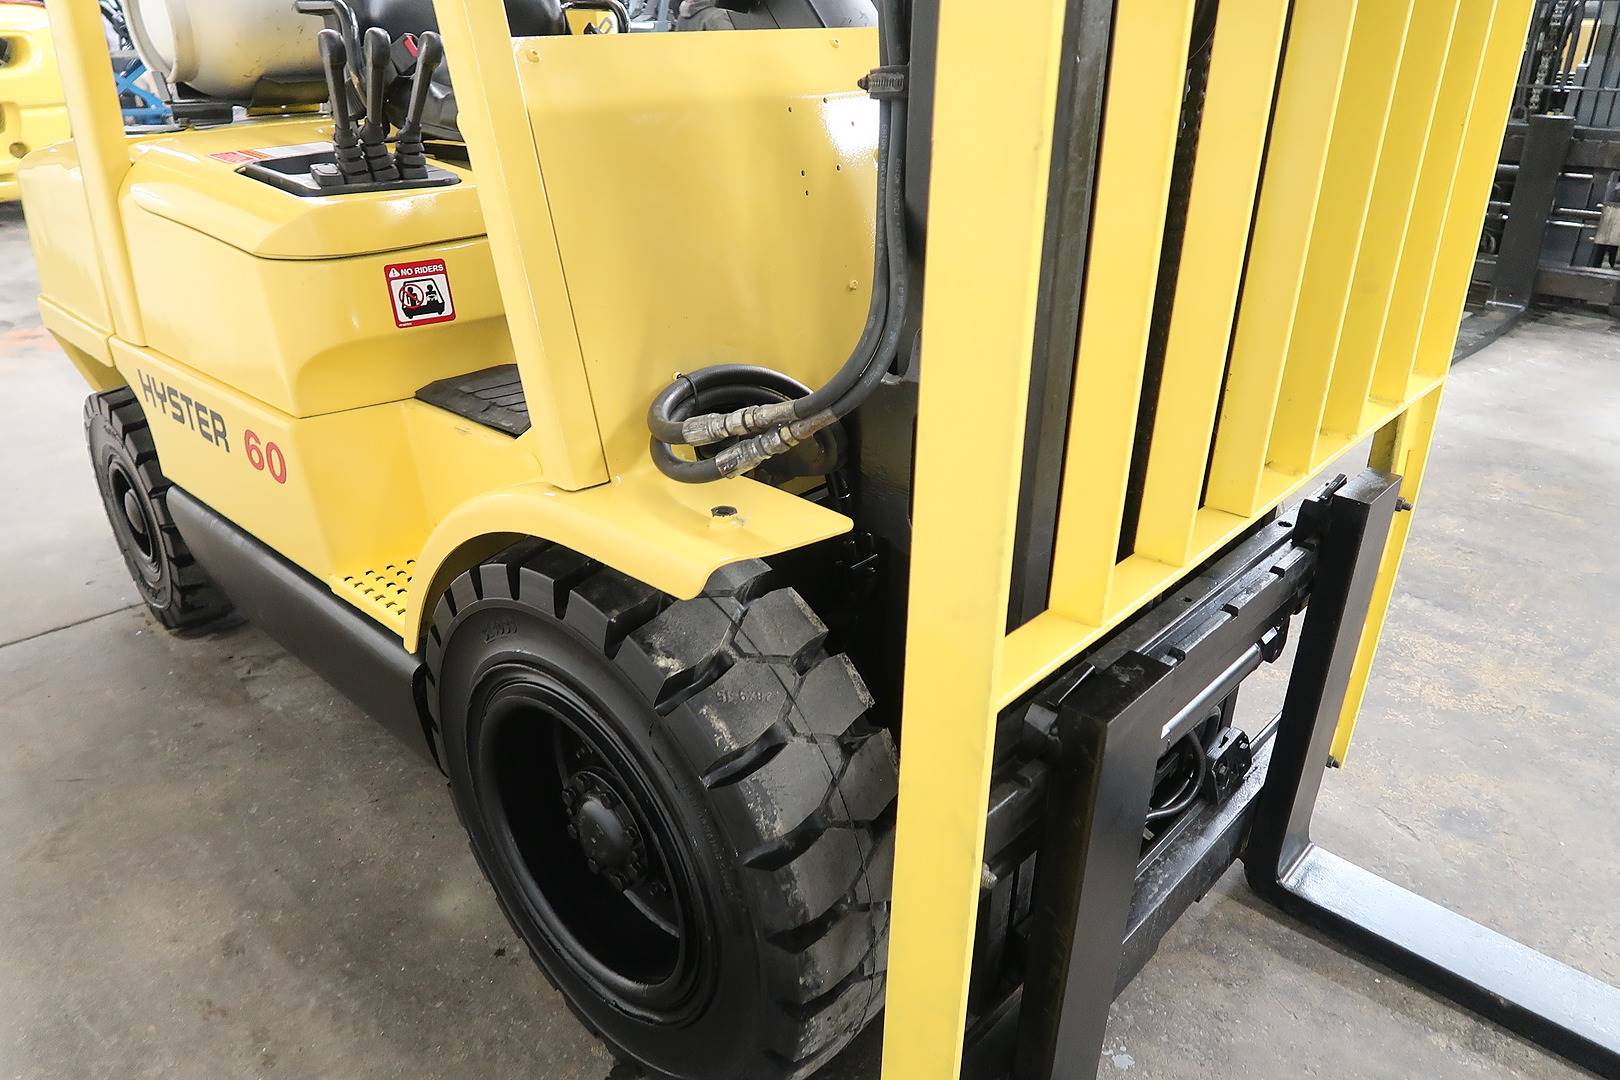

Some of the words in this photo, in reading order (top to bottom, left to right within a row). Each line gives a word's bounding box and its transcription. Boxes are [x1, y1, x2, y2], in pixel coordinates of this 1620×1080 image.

[400, 267, 413, 276] NO
[415, 264, 444, 275] RIDERS
[137, 368, 230, 453] HYSTER
[244, 428, 287, 484] 60
